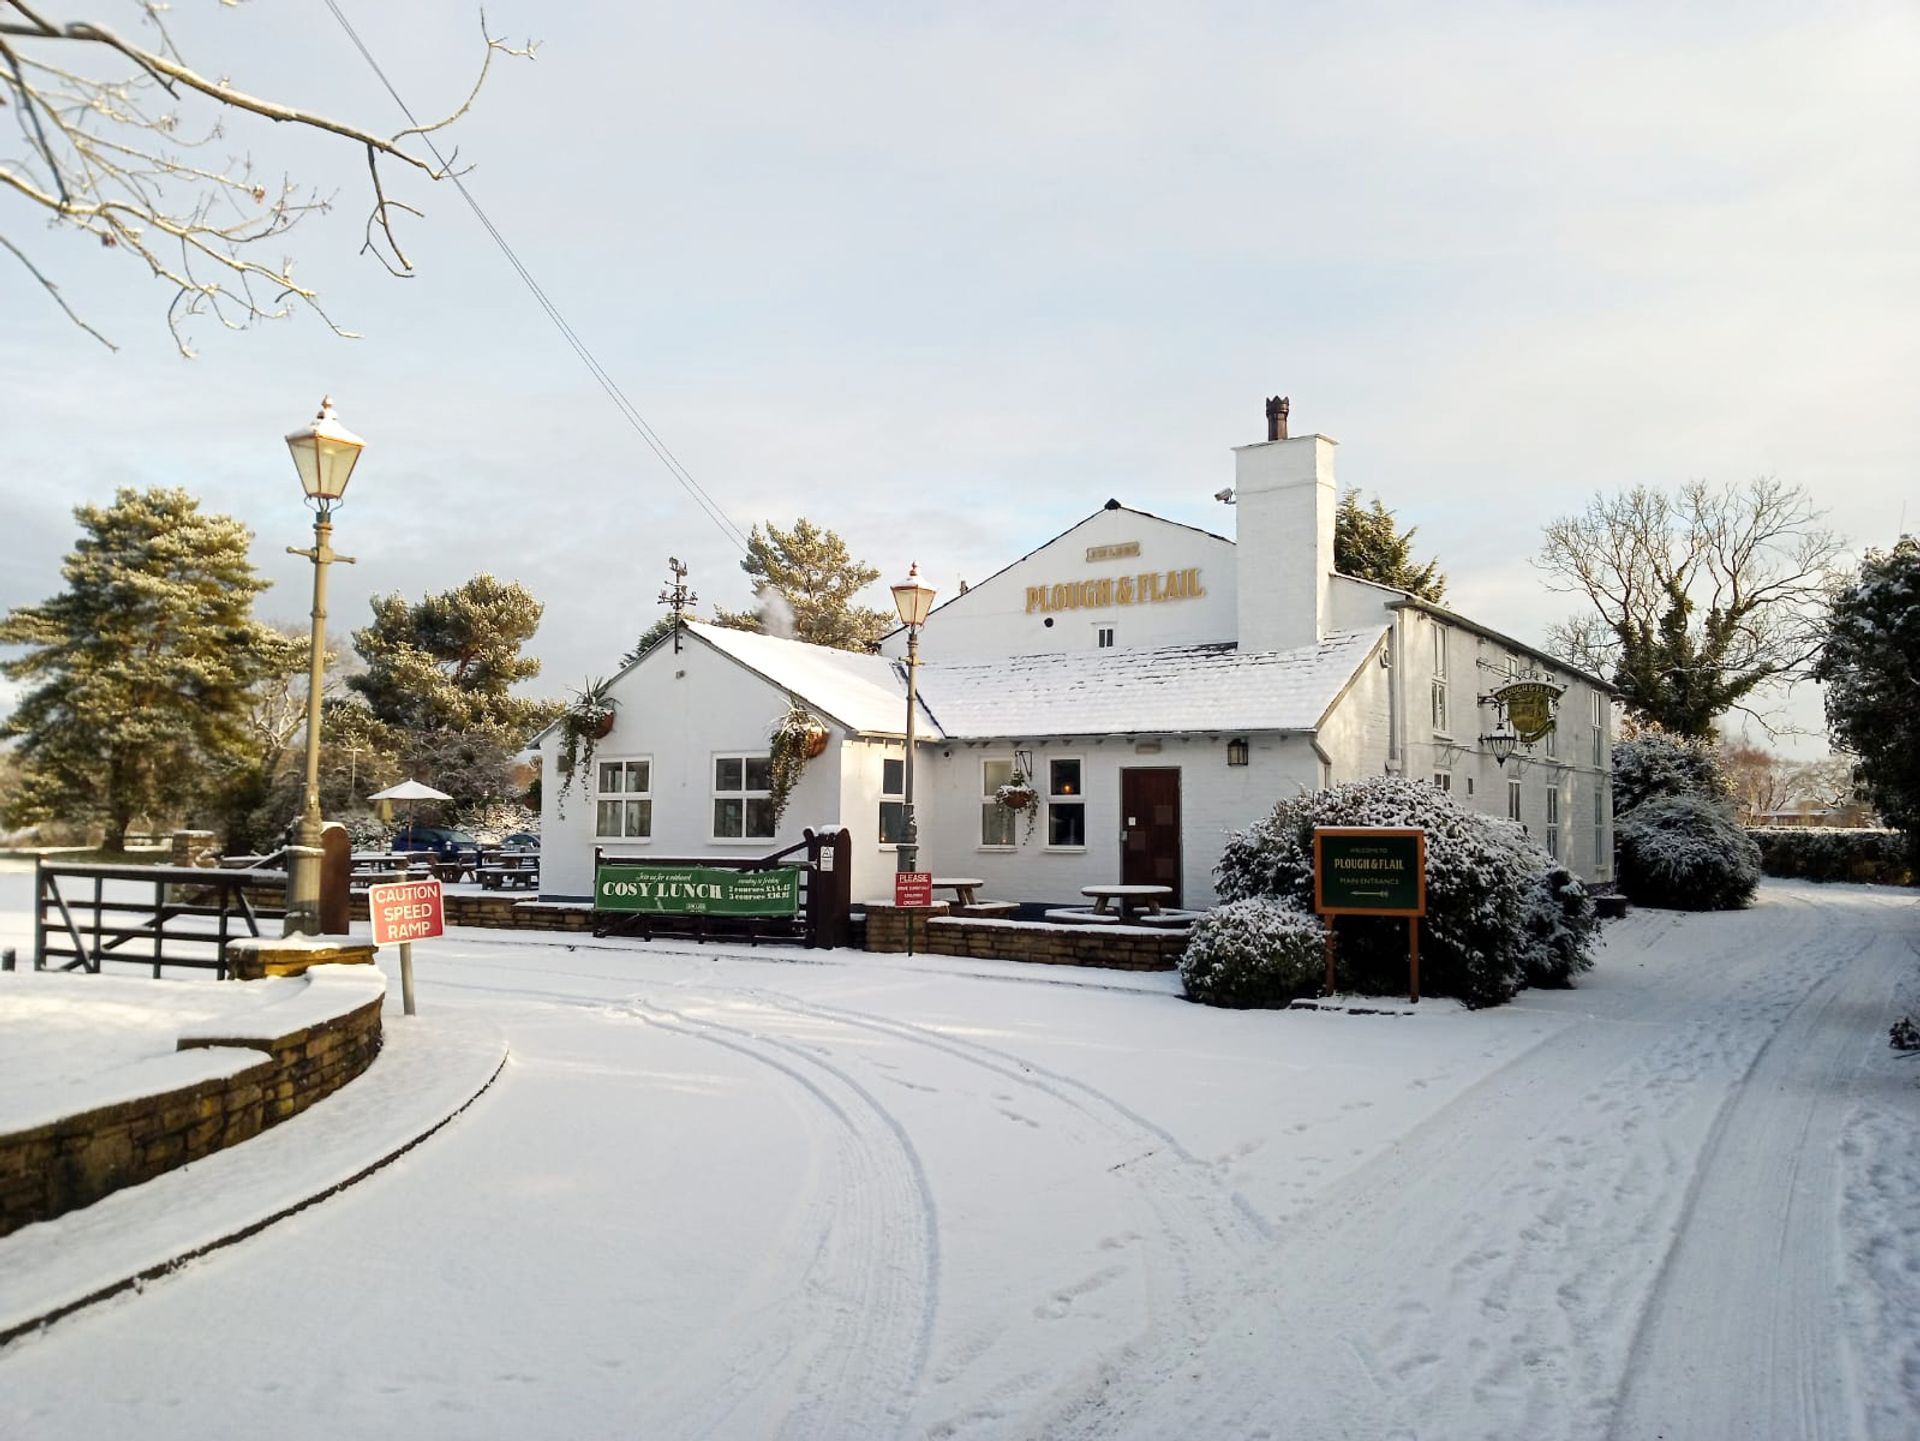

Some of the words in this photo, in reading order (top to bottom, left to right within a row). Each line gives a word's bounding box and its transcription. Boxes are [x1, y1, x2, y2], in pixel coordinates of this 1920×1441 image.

[1025, 577, 1112, 614] PLOUGH
[1116, 576, 1133, 604] &
[1137, 568, 1206, 601] FLAIL
[1497, 685, 1527, 701] PLOUGH
[1536, 685, 1558, 698] FLAIL
[1334, 858, 1369, 870] PLOUGH
[1371, 858, 1378, 869] &
[1379, 858, 1405, 870] FLAIL
[900, 874, 928, 883] PLEASE
[375, 885, 437, 903] CAUTION
[602, 882, 652, 897] COSY
[656, 882, 722, 899] LUNCH
[384, 903, 433, 921] SPEED
[387, 921, 431, 939] RAMP
